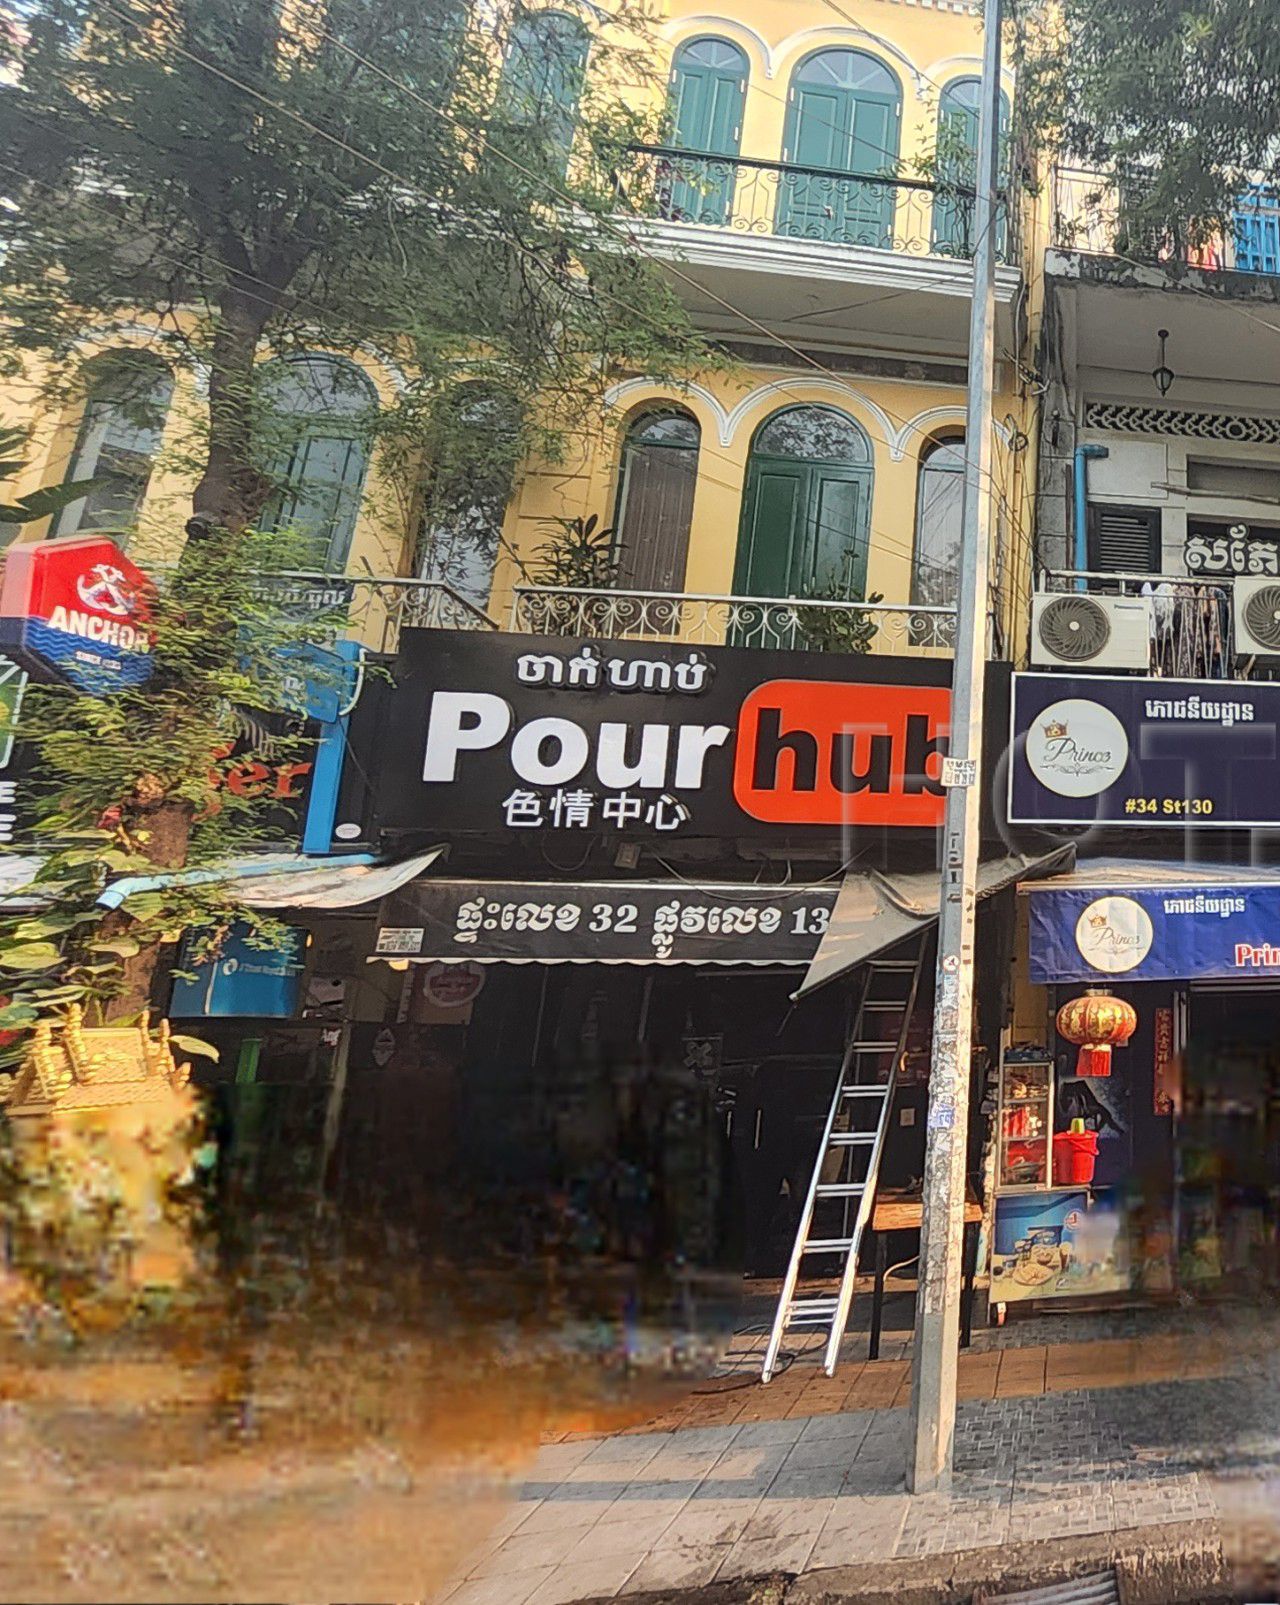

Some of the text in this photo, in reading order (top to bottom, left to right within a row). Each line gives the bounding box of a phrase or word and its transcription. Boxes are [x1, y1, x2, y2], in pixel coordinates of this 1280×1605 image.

[46, 604, 150, 653] ANCHOR
[422, 690, 948, 798] Pour hub
[502, 788, 691, 831] 色情中心
[1125, 798, 1213, 816] #34 St130
[588, 903, 638, 933] 32
